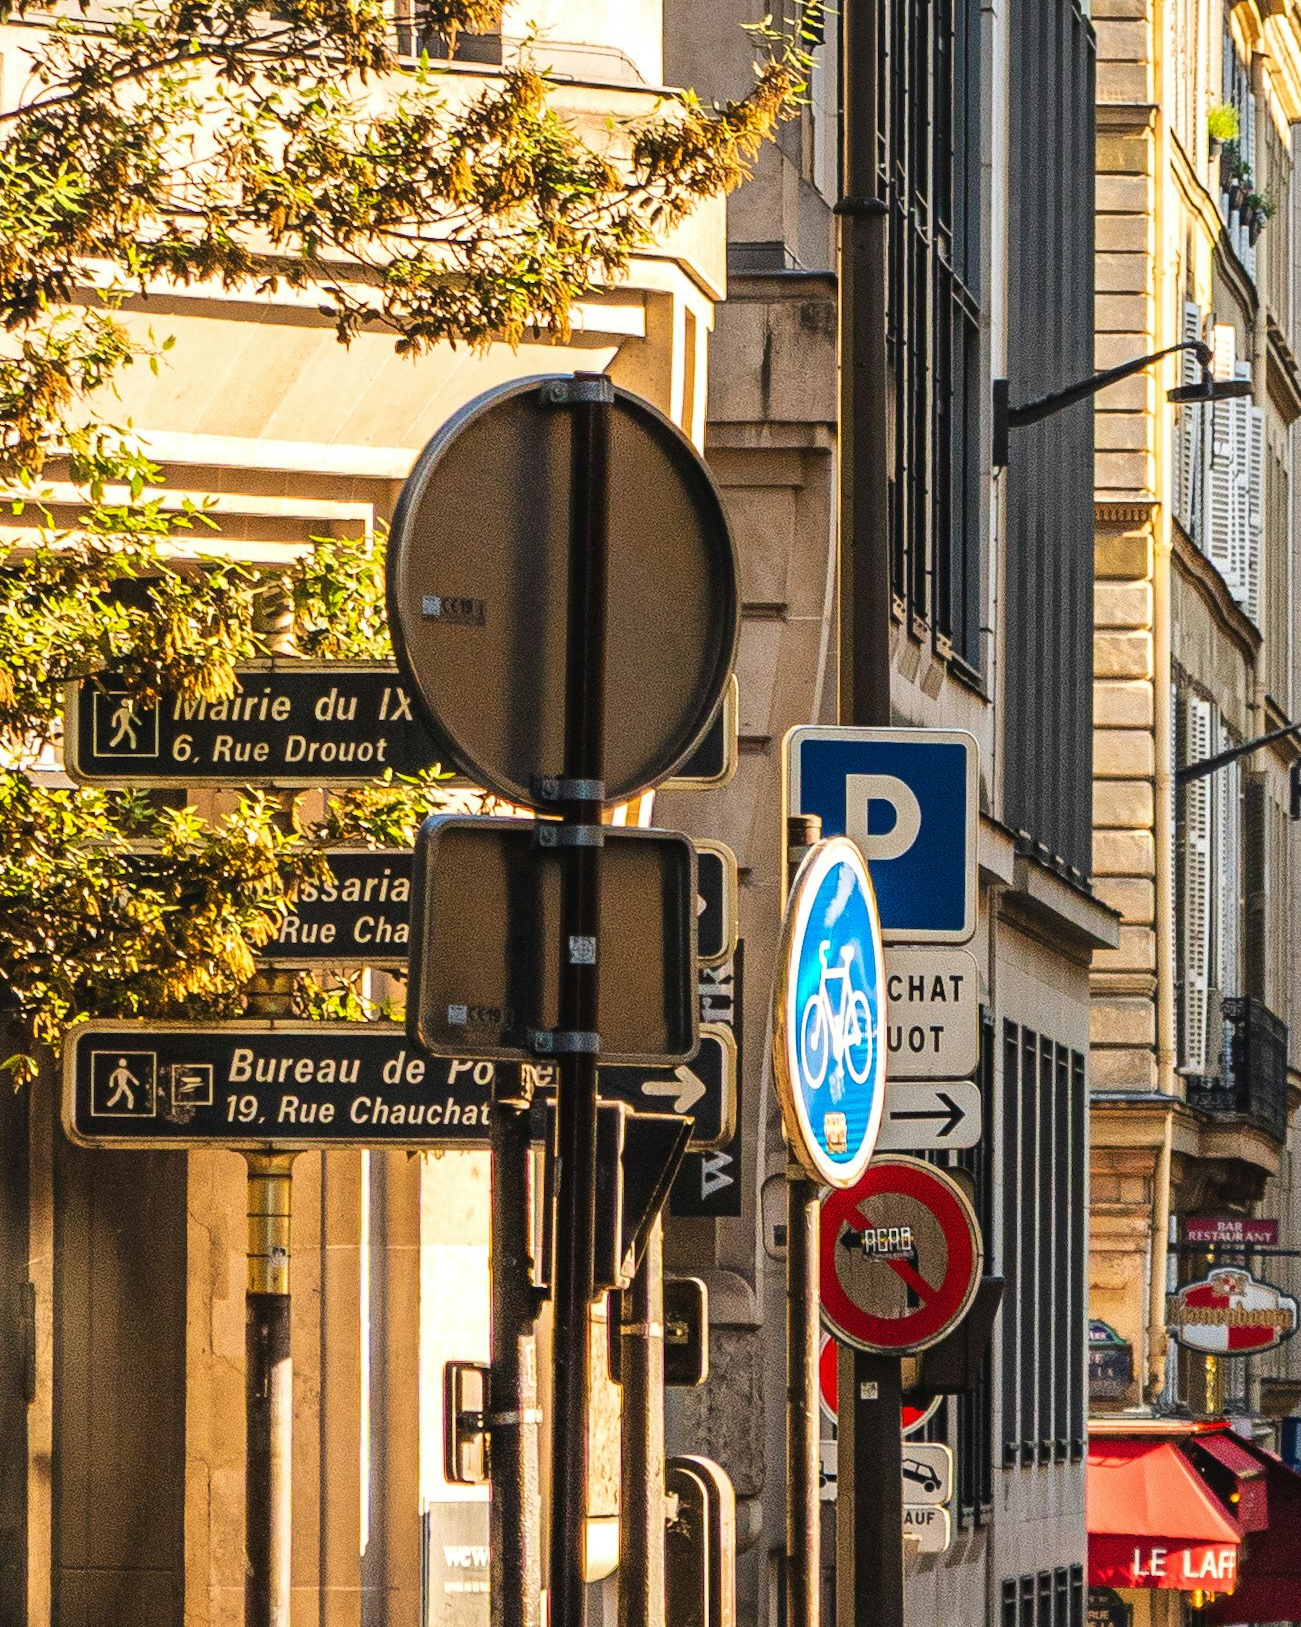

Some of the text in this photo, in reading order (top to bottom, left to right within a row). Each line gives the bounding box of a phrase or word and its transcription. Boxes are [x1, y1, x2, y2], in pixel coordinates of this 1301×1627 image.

[172, 687, 291, 721] Mairie
[315, 687, 356, 721] du
[172, 734, 387, 763] 6, Rue Drouot
[846, 774, 921, 860] P
[299, 868, 410, 902] ssaria
[279, 916, 336, 943] Rue
[353, 916, 410, 943] Cha
[888, 975, 964, 1002] CHAT
[887, 1026, 945, 1053] UOT
[228, 1049, 360, 1085] Bureau
[383, 1050, 425, 1085] de
[226, 1094, 491, 1125] 19, Rue Chauchat
[1187, 1231, 1272, 1243] RESTAURANT
[1217, 1221, 1243, 1232] BAR
[903, 1511, 935, 1526] AUF
[443, 1545, 489, 1568] wew
[1133, 1547, 1168, 1577] LE
